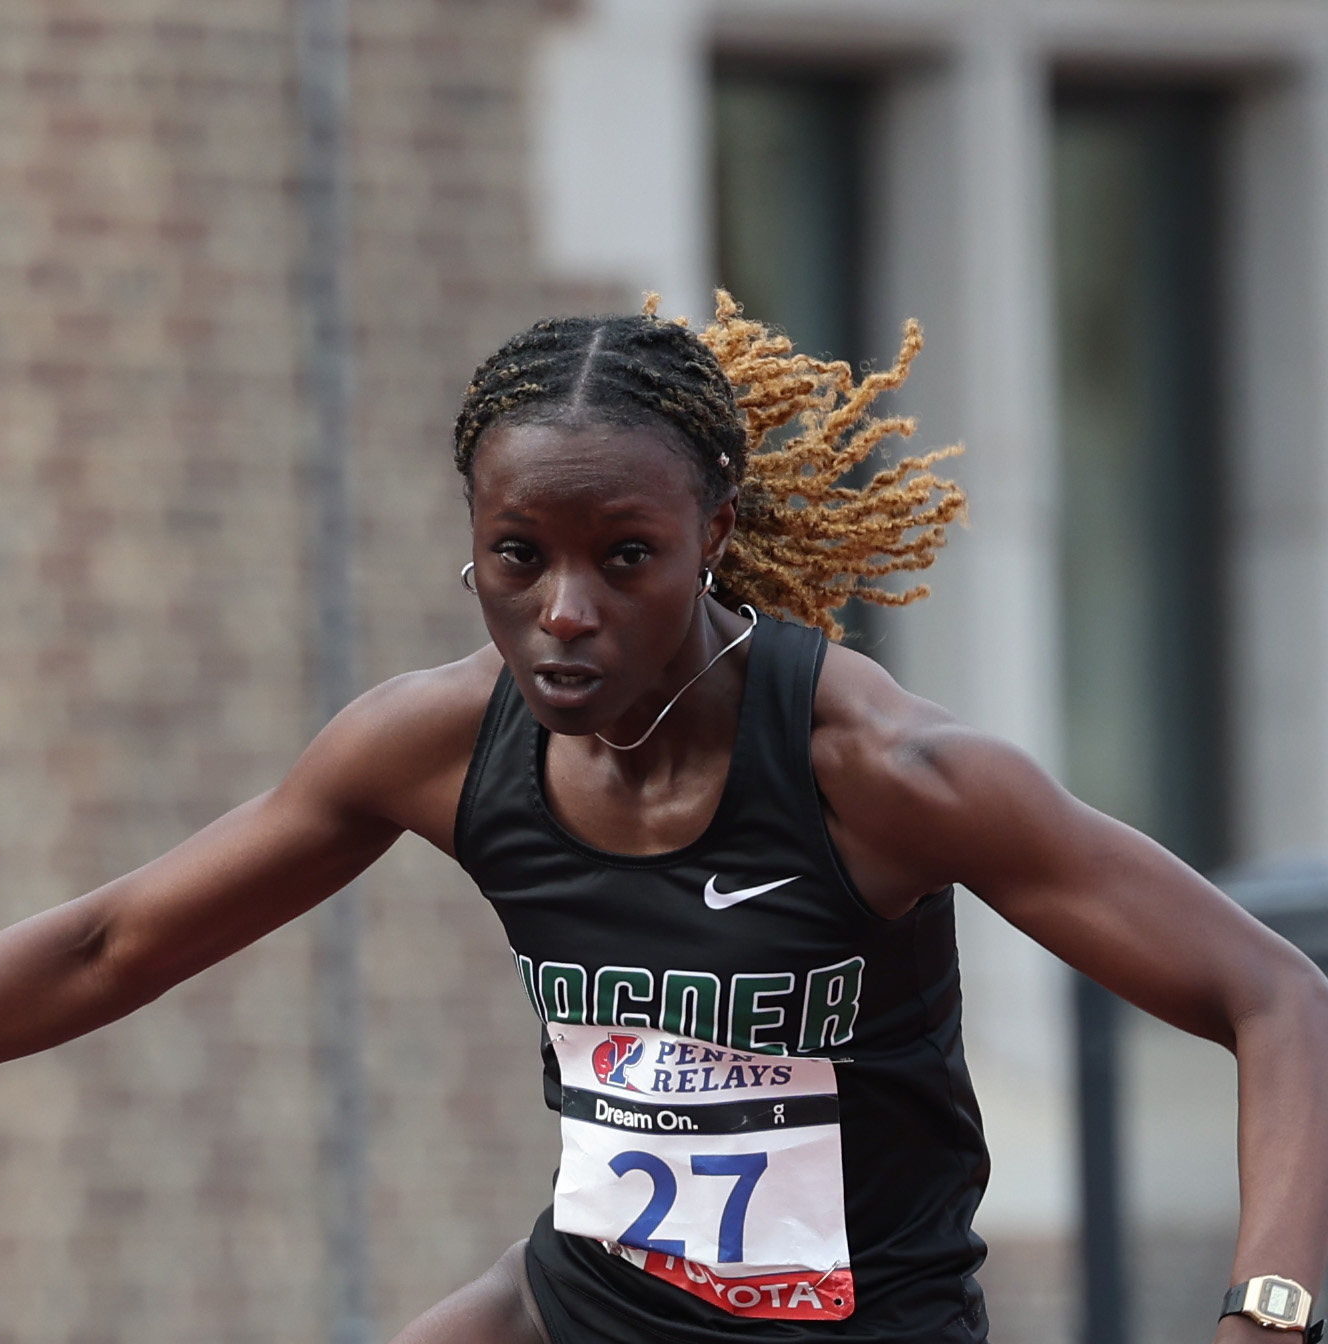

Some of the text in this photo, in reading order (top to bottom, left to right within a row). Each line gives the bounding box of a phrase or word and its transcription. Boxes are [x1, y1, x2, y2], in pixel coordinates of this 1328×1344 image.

[510, 947, 865, 1057] AGNER
[651, 1065, 792, 1093] RELAYS
[595, 1099, 699, 1130] Dream On.
[608, 1150, 768, 1263] 27
